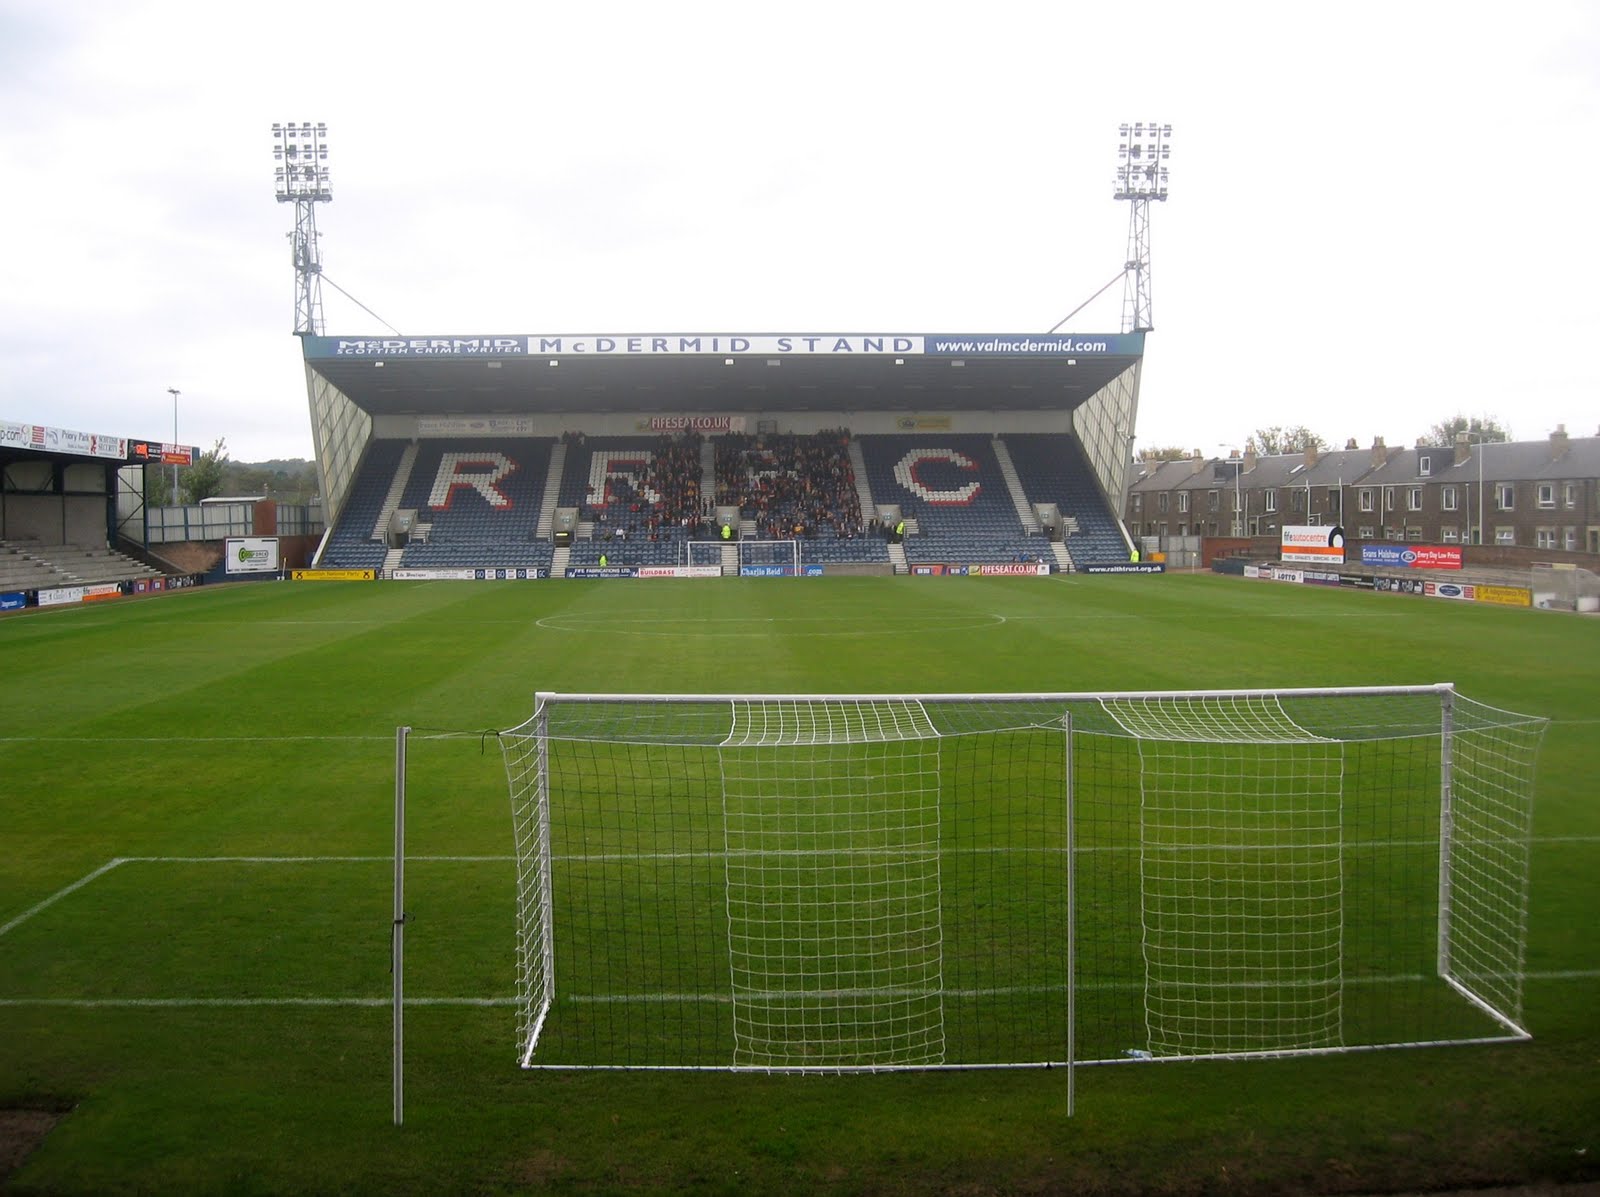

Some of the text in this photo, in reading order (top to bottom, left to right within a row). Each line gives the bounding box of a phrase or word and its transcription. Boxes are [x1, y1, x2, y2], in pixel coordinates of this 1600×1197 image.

[540, 338, 913, 353] McDERMID STAND
[935, 339, 1107, 352] www.valmcdermid.com
[651, 416, 729, 429] FIFESEAT.CO.UK
[1362, 549, 1400, 559] Evans Halshaw
[741, 567, 766, 577] Charlie
[981, 564, 1038, 575] FIFESEAT.CO.UK
[1088, 565, 1162, 573] www.raithtrust.org.uk
[1277, 573, 1296, 581] LOTTO
